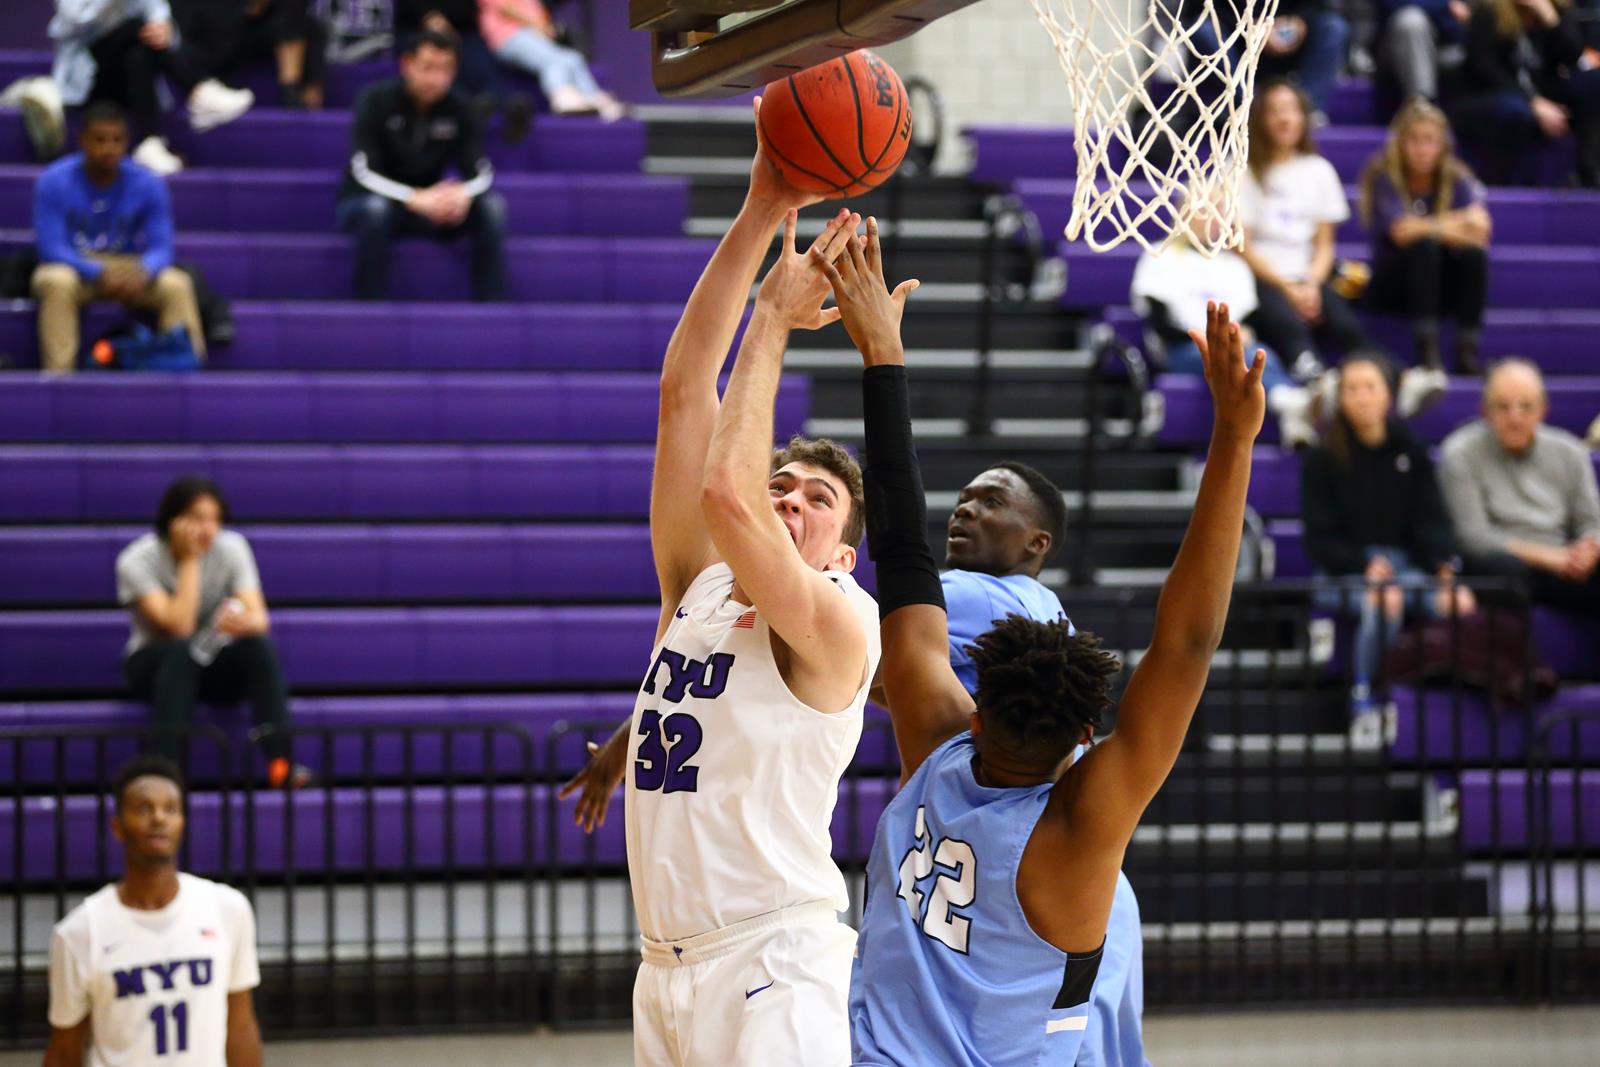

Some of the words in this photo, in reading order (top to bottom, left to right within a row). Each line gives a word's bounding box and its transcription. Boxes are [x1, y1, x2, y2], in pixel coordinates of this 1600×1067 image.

[635, 709, 703, 794] 32
[896, 804, 977, 956] 22
[113, 958, 213, 998] NYU
[150, 1002, 188, 1055] 11
